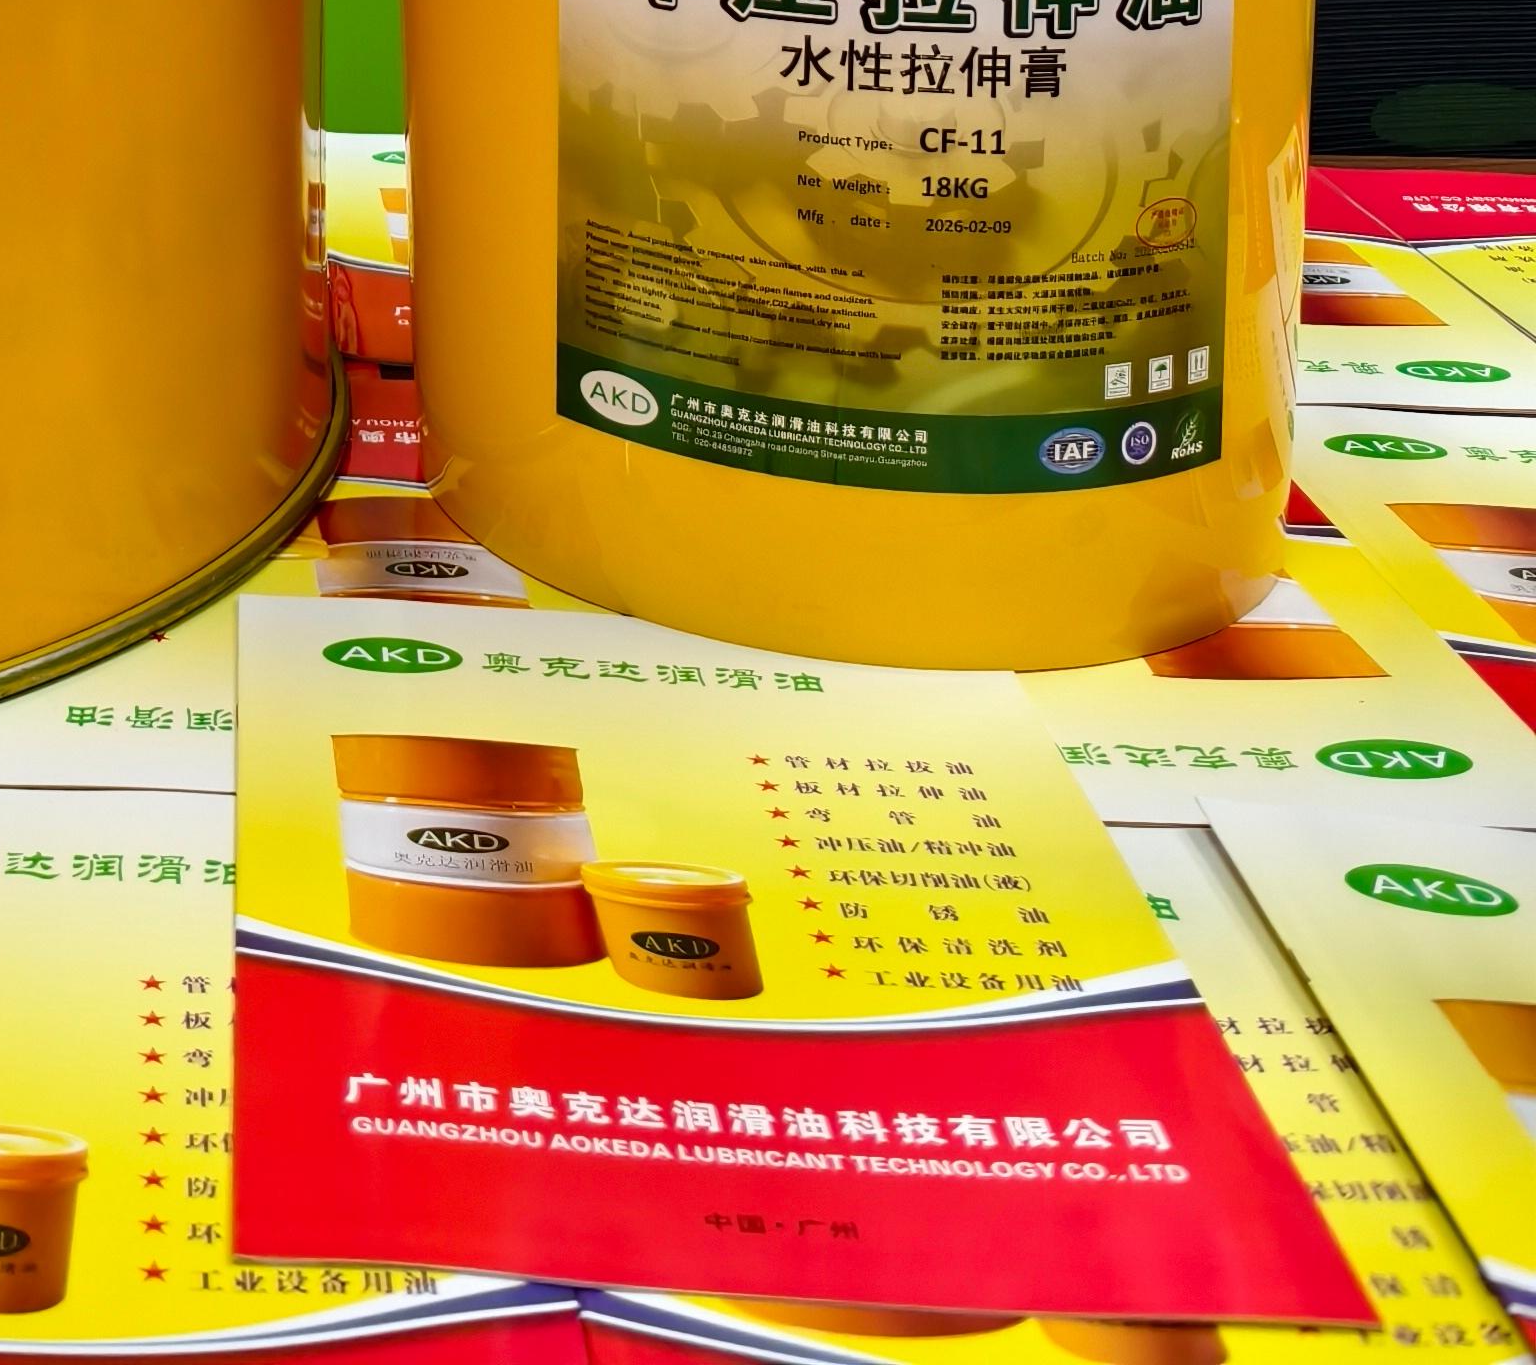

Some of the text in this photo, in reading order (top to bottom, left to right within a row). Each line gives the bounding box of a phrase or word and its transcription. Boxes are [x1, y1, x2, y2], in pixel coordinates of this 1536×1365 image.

[781, 35, 1068, 100] 水性拉伸膏
[798, 130, 851, 147] Product
[919, 127, 1006, 155] CF-11
[797, 174, 822, 188] Net
[921, 176, 989, 200] 18KG
[925, 218, 1012, 234] 2026-02-09
[749, 255, 767, 266] skin
[1071, 250, 1105, 264] Batch
[1405, 365, 1492, 379] AKD
[589, 380, 652, 416] AKD
[670, 393, 928, 444] 广州市奥克达润滑油科技有限公司
[670, 407, 727, 429] GUANGZHOU
[729, 422, 767, 436] AOKEDA
[768, 429, 821, 444] LUBRICANT
[824, 436, 886, 453] TECHNOLOGY
[1054, 434, 1204, 462] IAF ISO RoHS
[1344, 439, 1436, 454] AKD
[394, 563, 459, 576] AKD
[339, 645, 825, 694] AKD 奥克达润滑油
[784, 755, 975, 776] 管材拉拔油
[1329, 750, 1446, 769] AKD
[794, 781, 988, 802] 板材拉伸油
[417, 829, 500, 850] AKD
[814, 836, 1017, 858] 冲压油/精冲油
[829, 869, 1032, 892] 环保切削油(液)
[1373, 873, 1502, 906] AKD
[645, 935, 709, 956] AKD
[853, 935, 1068, 959] 环保清洗剂
[865, 969, 1086, 993] 工业设备用油
[343, 1072, 1173, 1153] 广州市奥克达润滑油科技有限公司
[350, 1115, 543, 1149] GUANGZHOU
[550, 1133, 673, 1161] AOKEDA
[677, 1142, 845, 1172] LUBRICANT
[851, 1154, 1055, 1181] TECHNOLOGY
[189, 1269, 440, 1296] 工业设备用油
